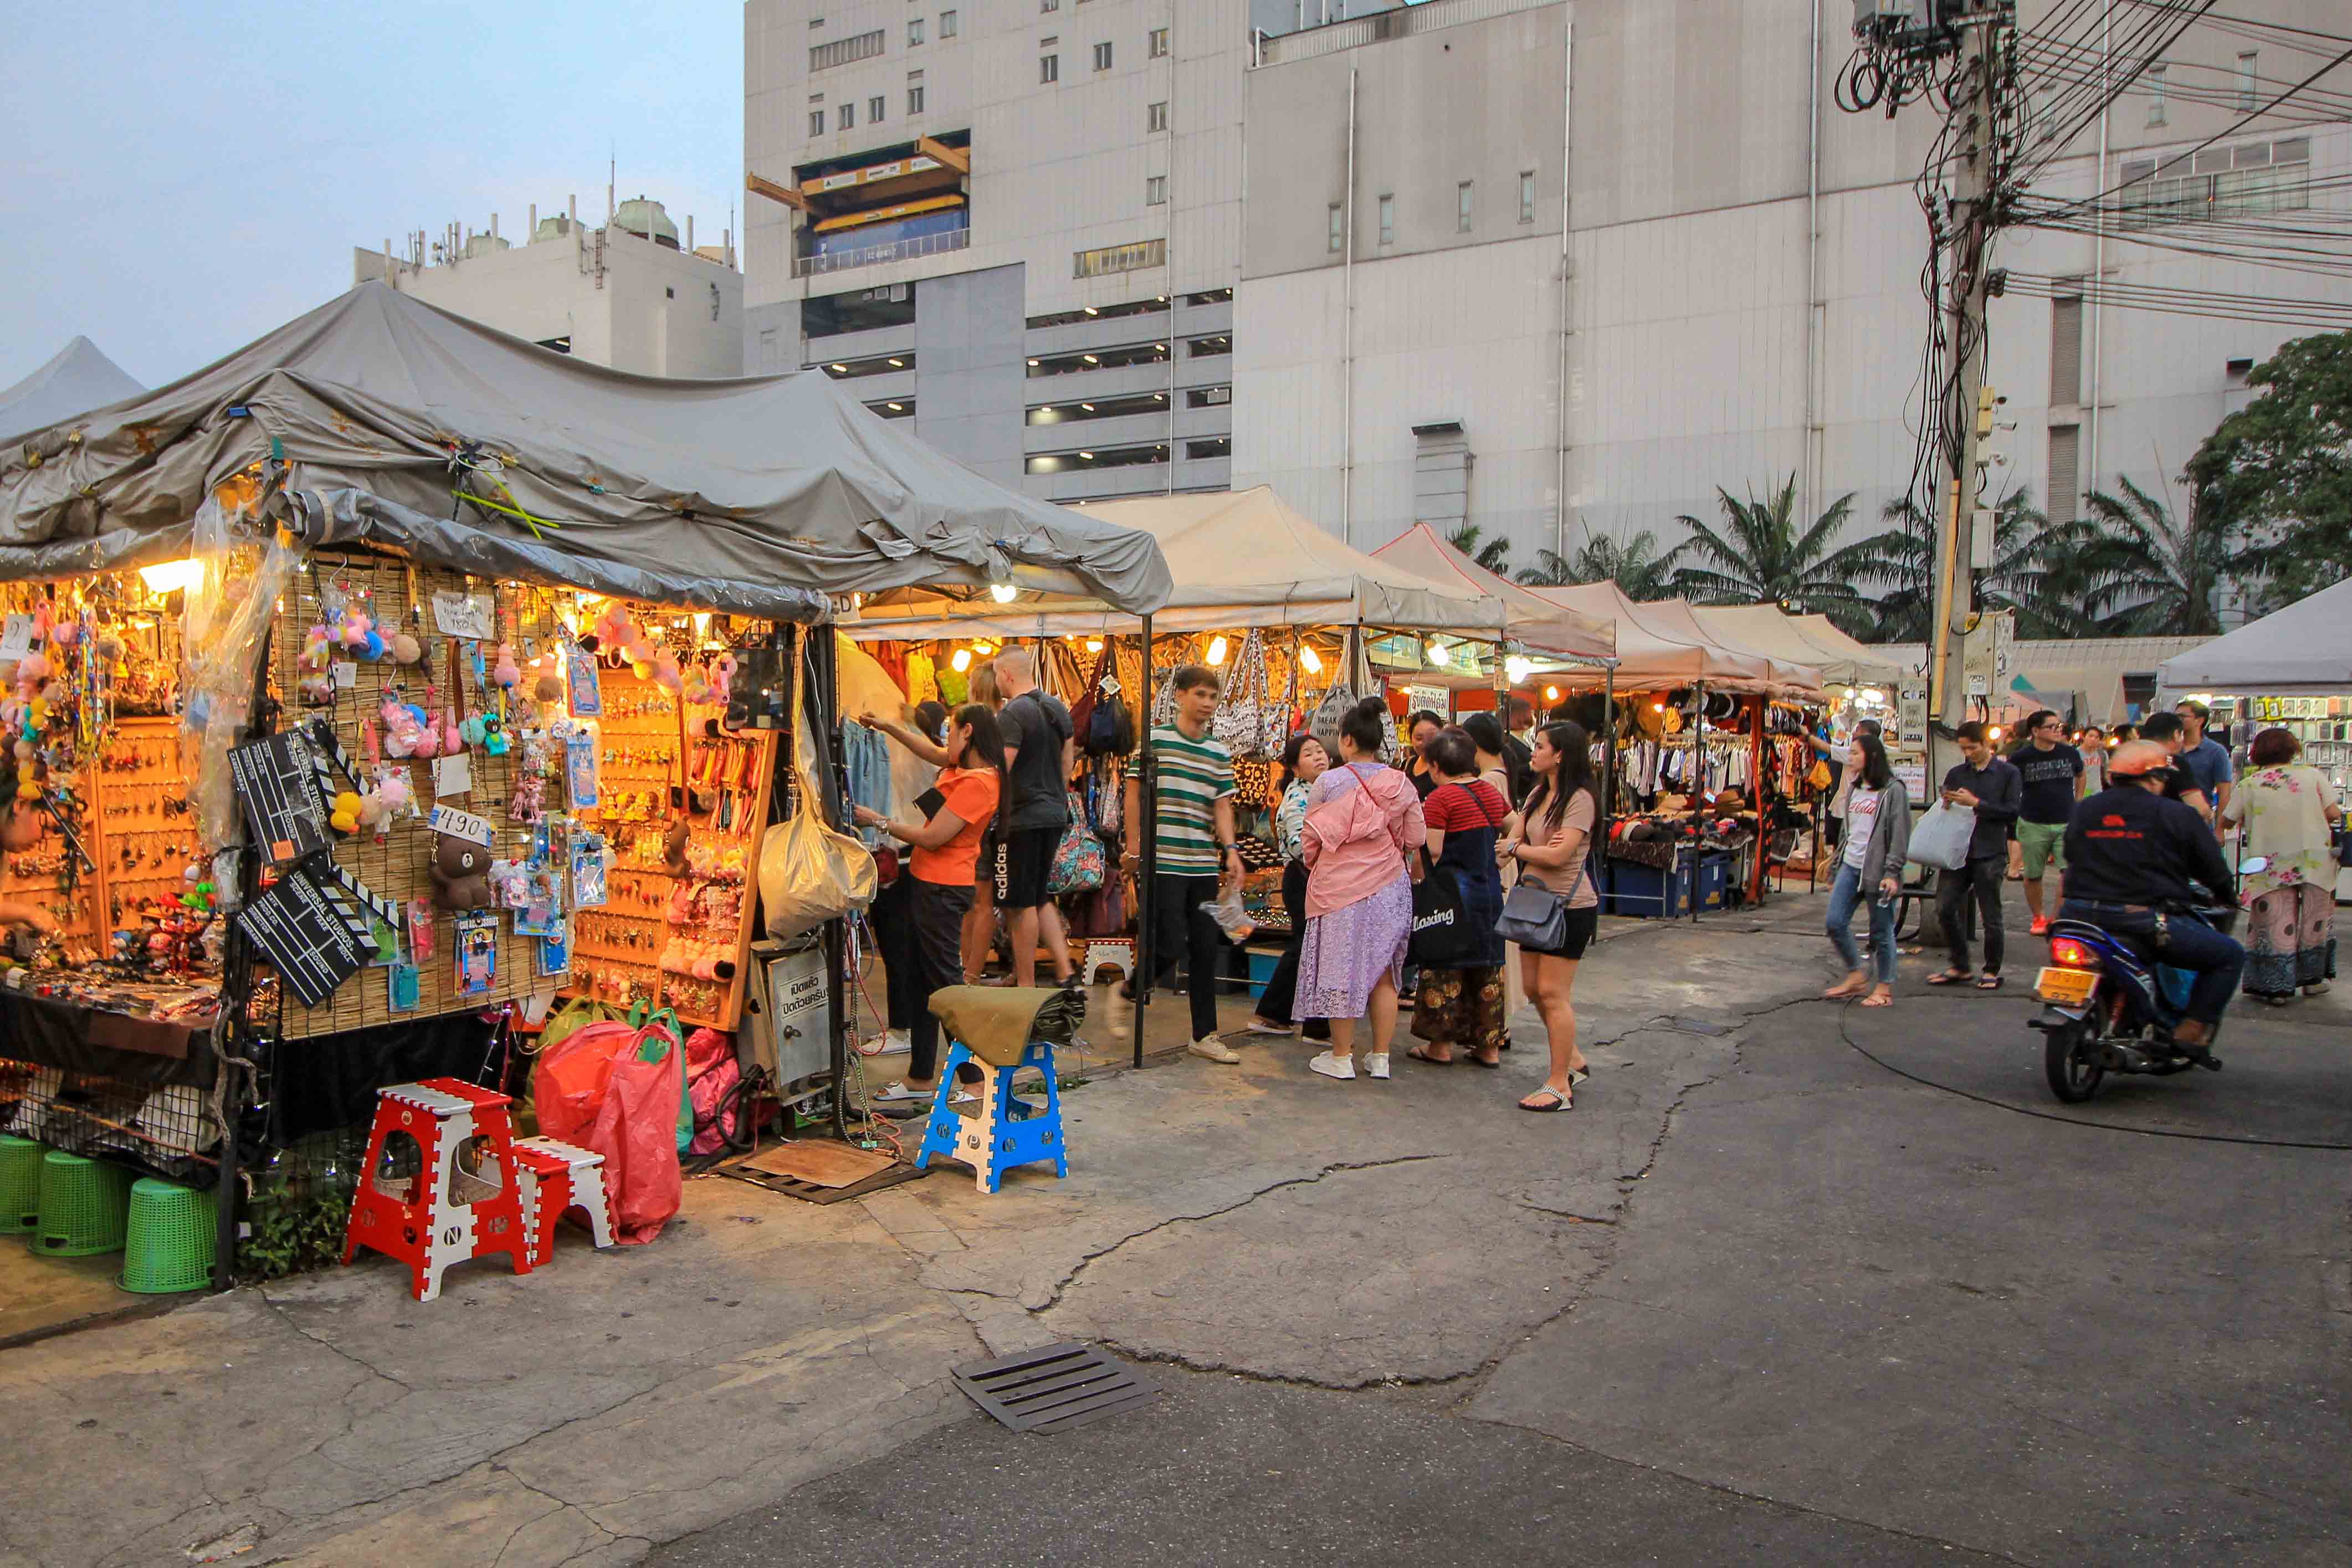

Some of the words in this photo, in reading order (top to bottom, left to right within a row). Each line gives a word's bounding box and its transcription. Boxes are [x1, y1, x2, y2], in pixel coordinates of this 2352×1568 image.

[1316, 728, 1340, 736] HAPPIN
[284, 812, 297, 839] SOUND
[994, 843, 1007, 899] adidas
[266, 893, 278, 908] DATE
[289, 882, 308, 904] SCENE
[294, 870, 329, 915] UNIVERSAL
[247, 907, 270, 934] DIRECTOR
[314, 915, 329, 931] TAKE
[1413, 909, 1454, 931] laxing
[237, 915, 265, 949] CAMERAMAN
[309, 950, 329, 975] SOUND
[337, 945, 351, 963] ROLL
[791, 976, 818, 996] เปิดแล้ว
